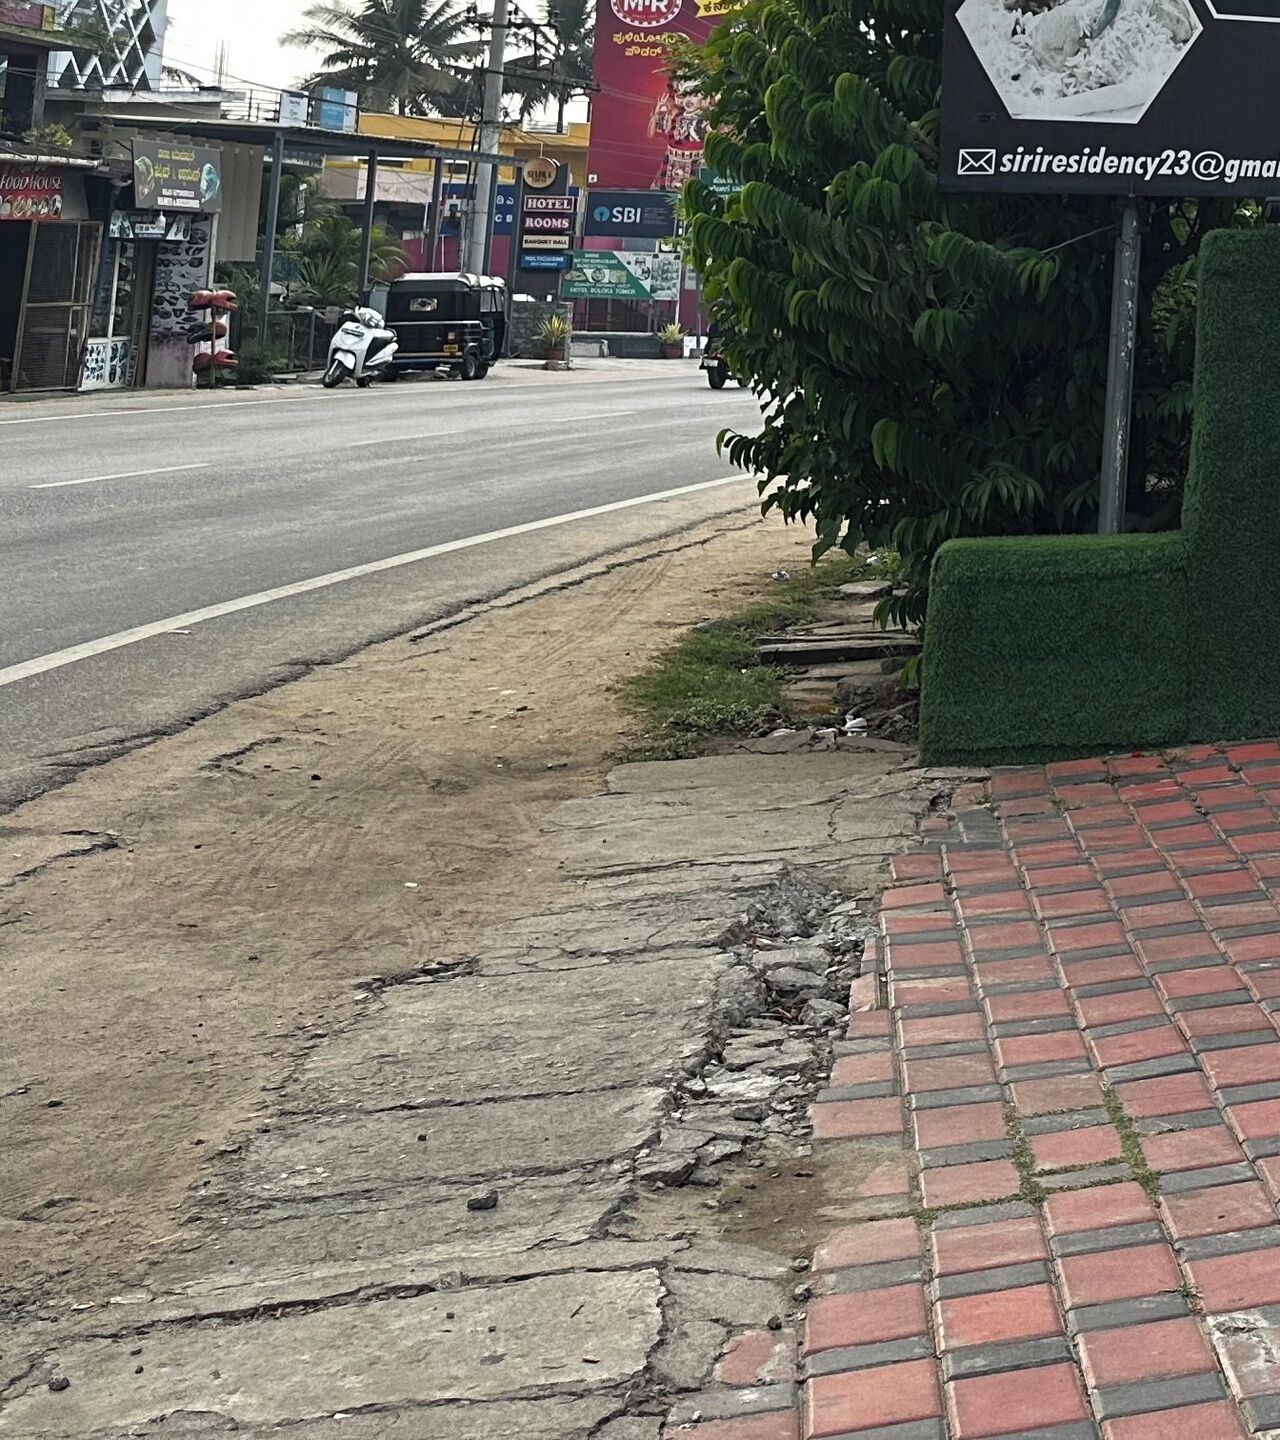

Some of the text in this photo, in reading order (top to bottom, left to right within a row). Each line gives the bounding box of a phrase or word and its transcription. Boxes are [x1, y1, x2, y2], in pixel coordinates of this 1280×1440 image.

[0, 174, 29, 190] FOOD
[526, 198, 571, 209] HOTEL
[611, 207, 642, 223] SBI
[525, 217, 570, 228] ROOMS
